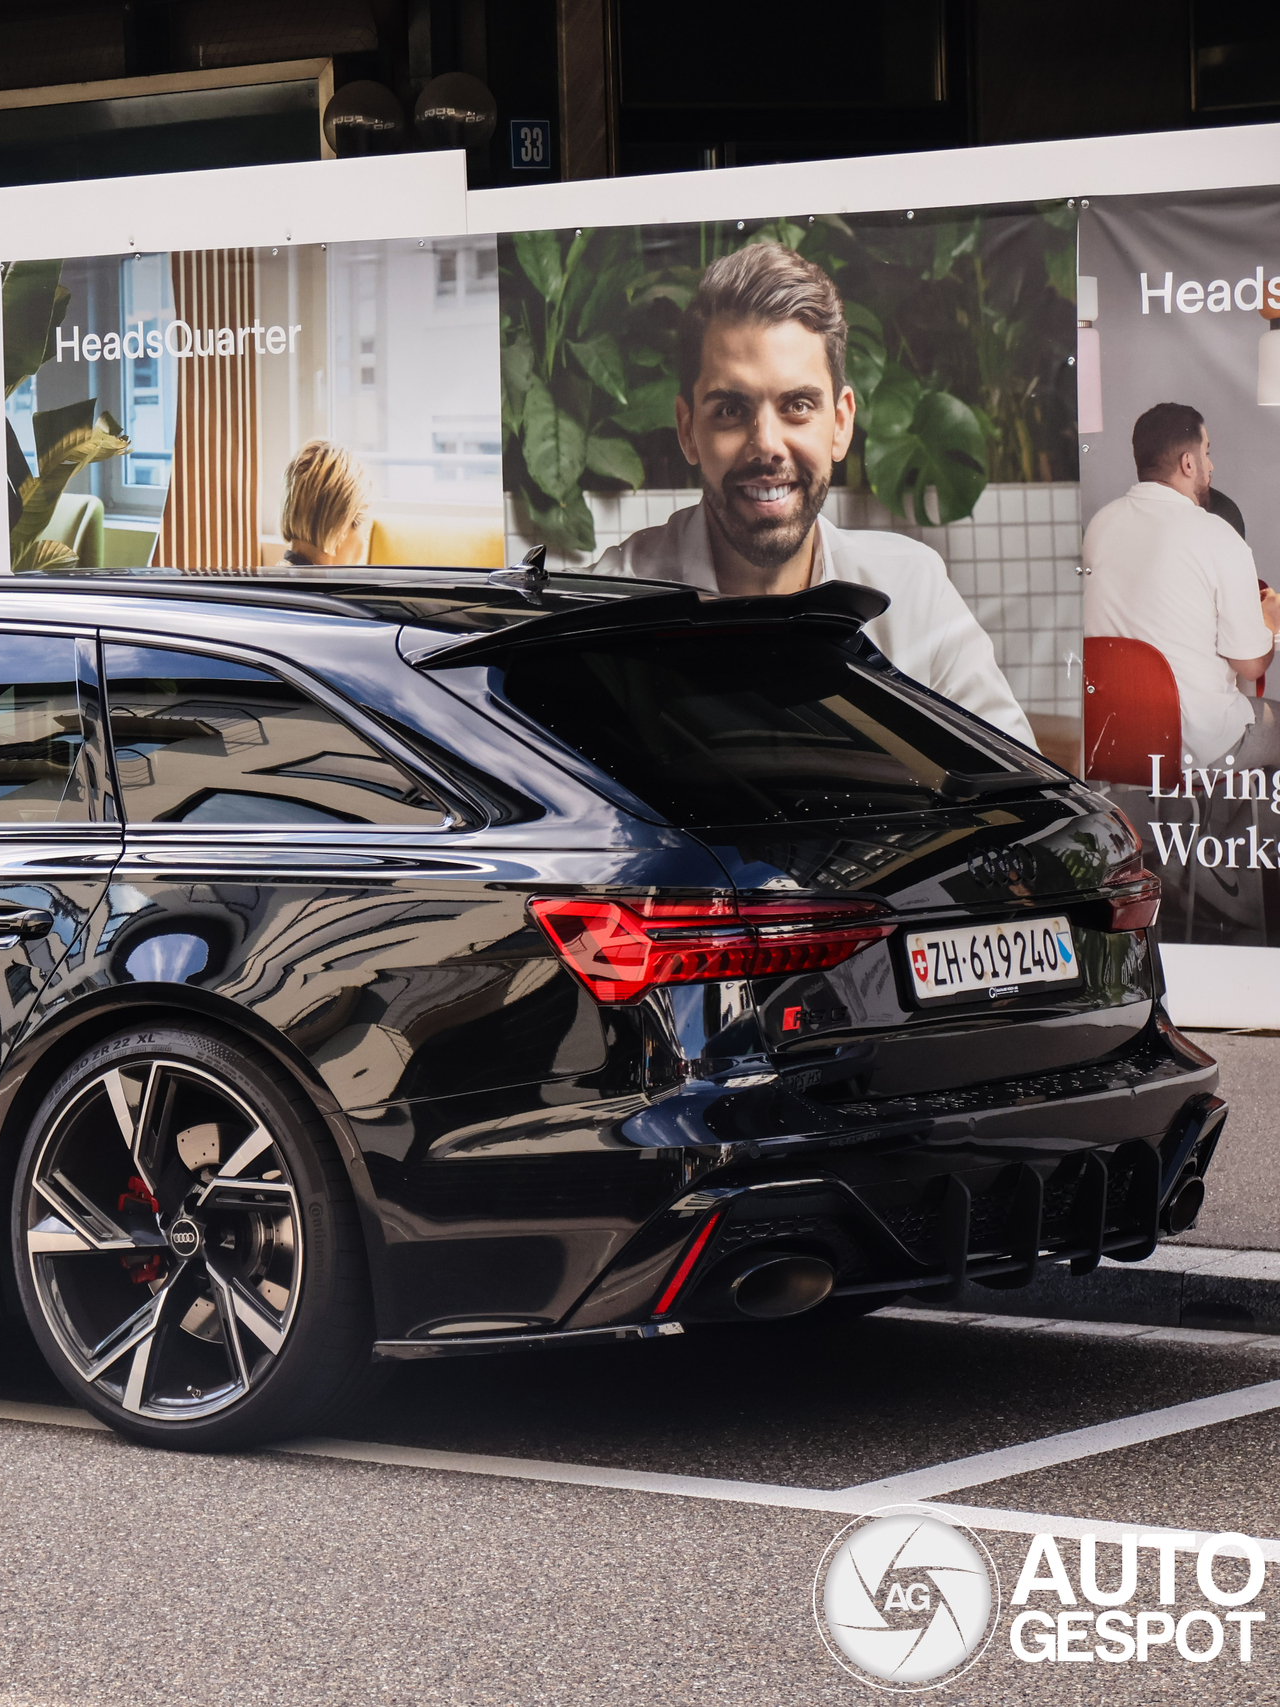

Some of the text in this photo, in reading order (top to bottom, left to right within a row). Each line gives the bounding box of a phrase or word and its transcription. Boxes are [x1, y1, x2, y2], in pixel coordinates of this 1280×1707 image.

[521, 126, 543, 162] 33
[55, 318, 302, 363] HeadsQuarter
[1147, 821, 1280, 871] Work
[92, 1045, 110, 1061] ZR
[113, 1037, 131, 1051] 22
[136, 1033, 156, 1045] XL
